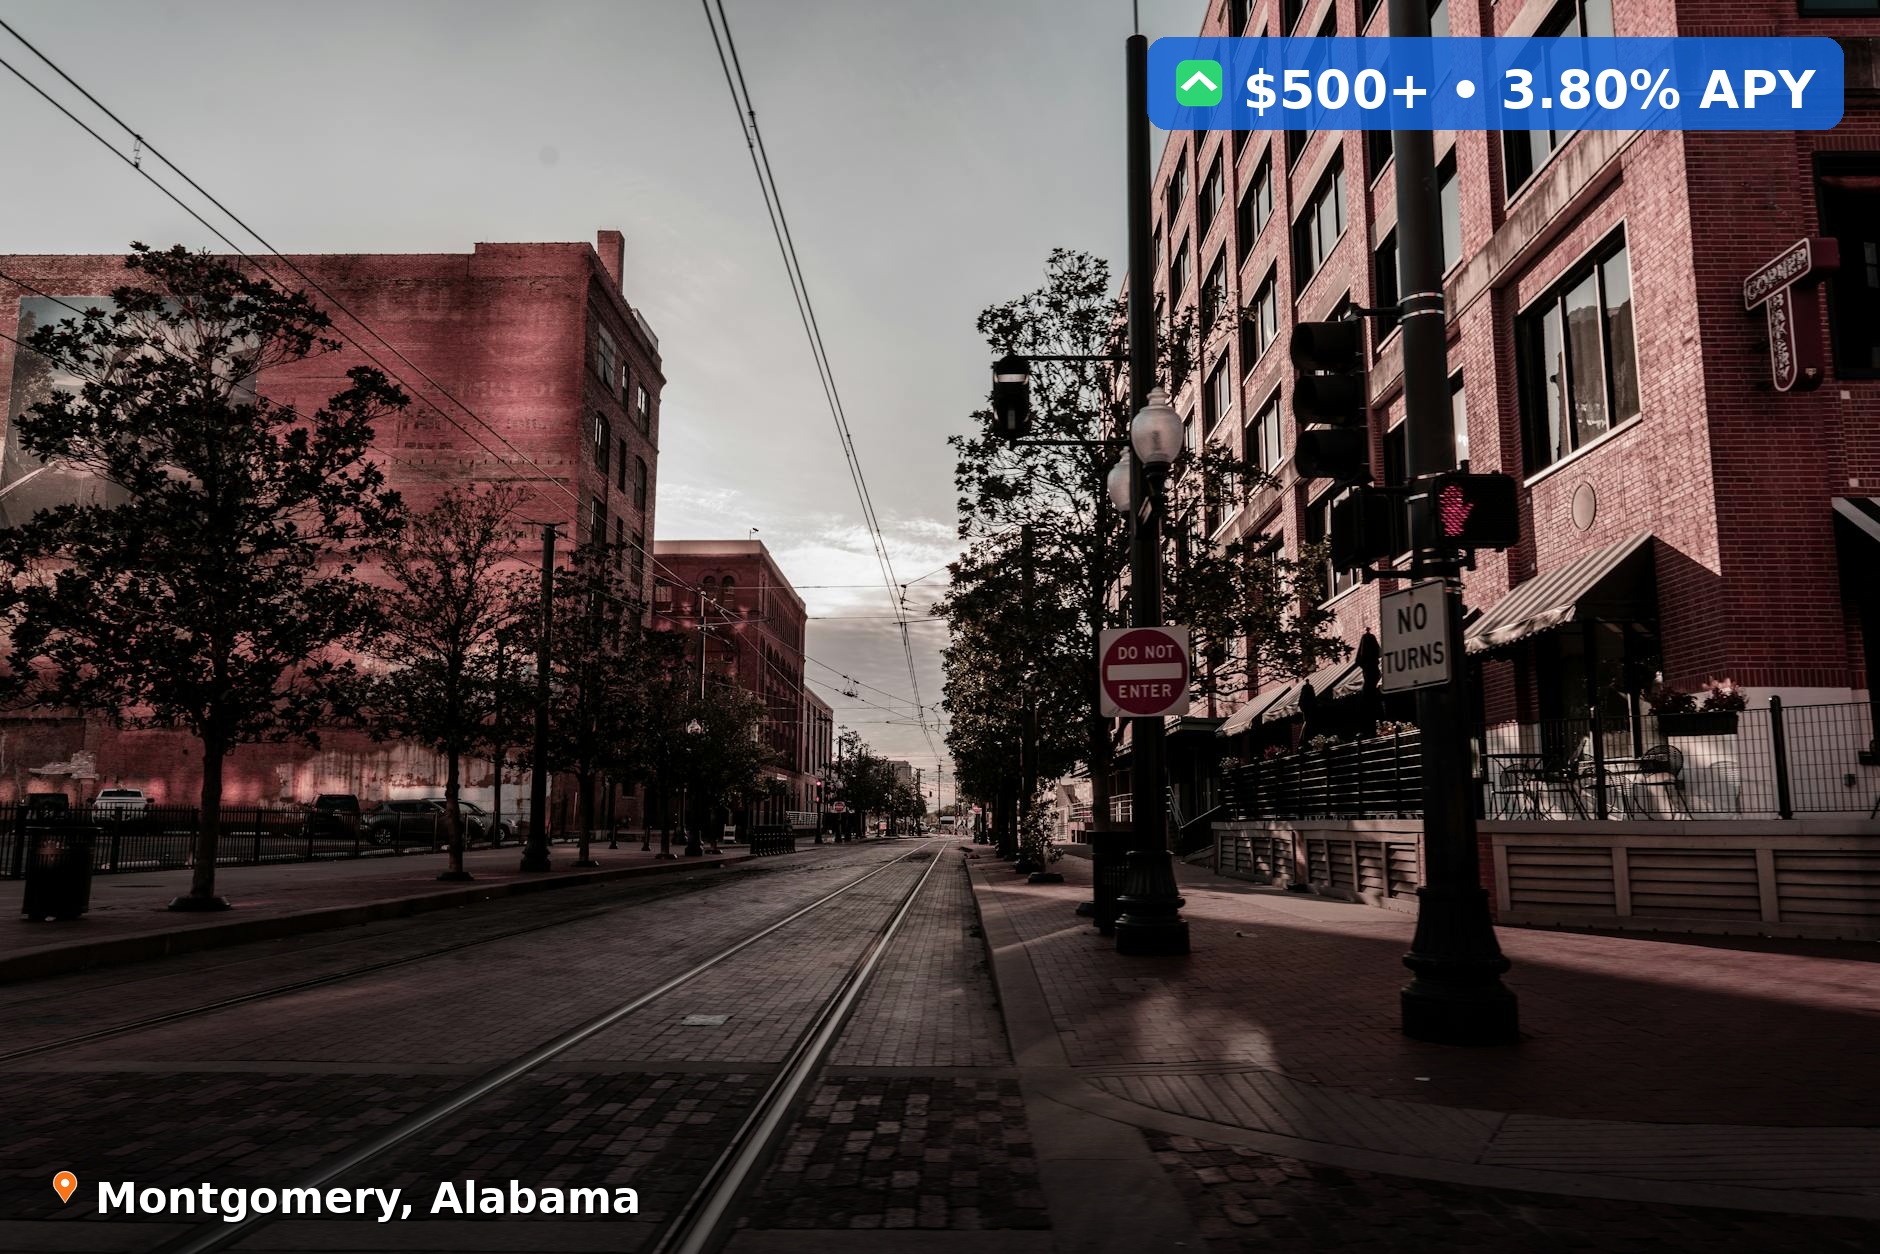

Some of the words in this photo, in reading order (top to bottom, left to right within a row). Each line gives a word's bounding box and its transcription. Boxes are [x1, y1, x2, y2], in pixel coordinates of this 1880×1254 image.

[1748, 247, 1807, 301] CORNER
[1397, 603, 1427, 635] NO
[1118, 646, 1139, 660] DO
[1145, 645, 1175, 659] NOT
[1384, 642, 1445, 674] TURNS
[1118, 683, 1172, 699] ENTER
